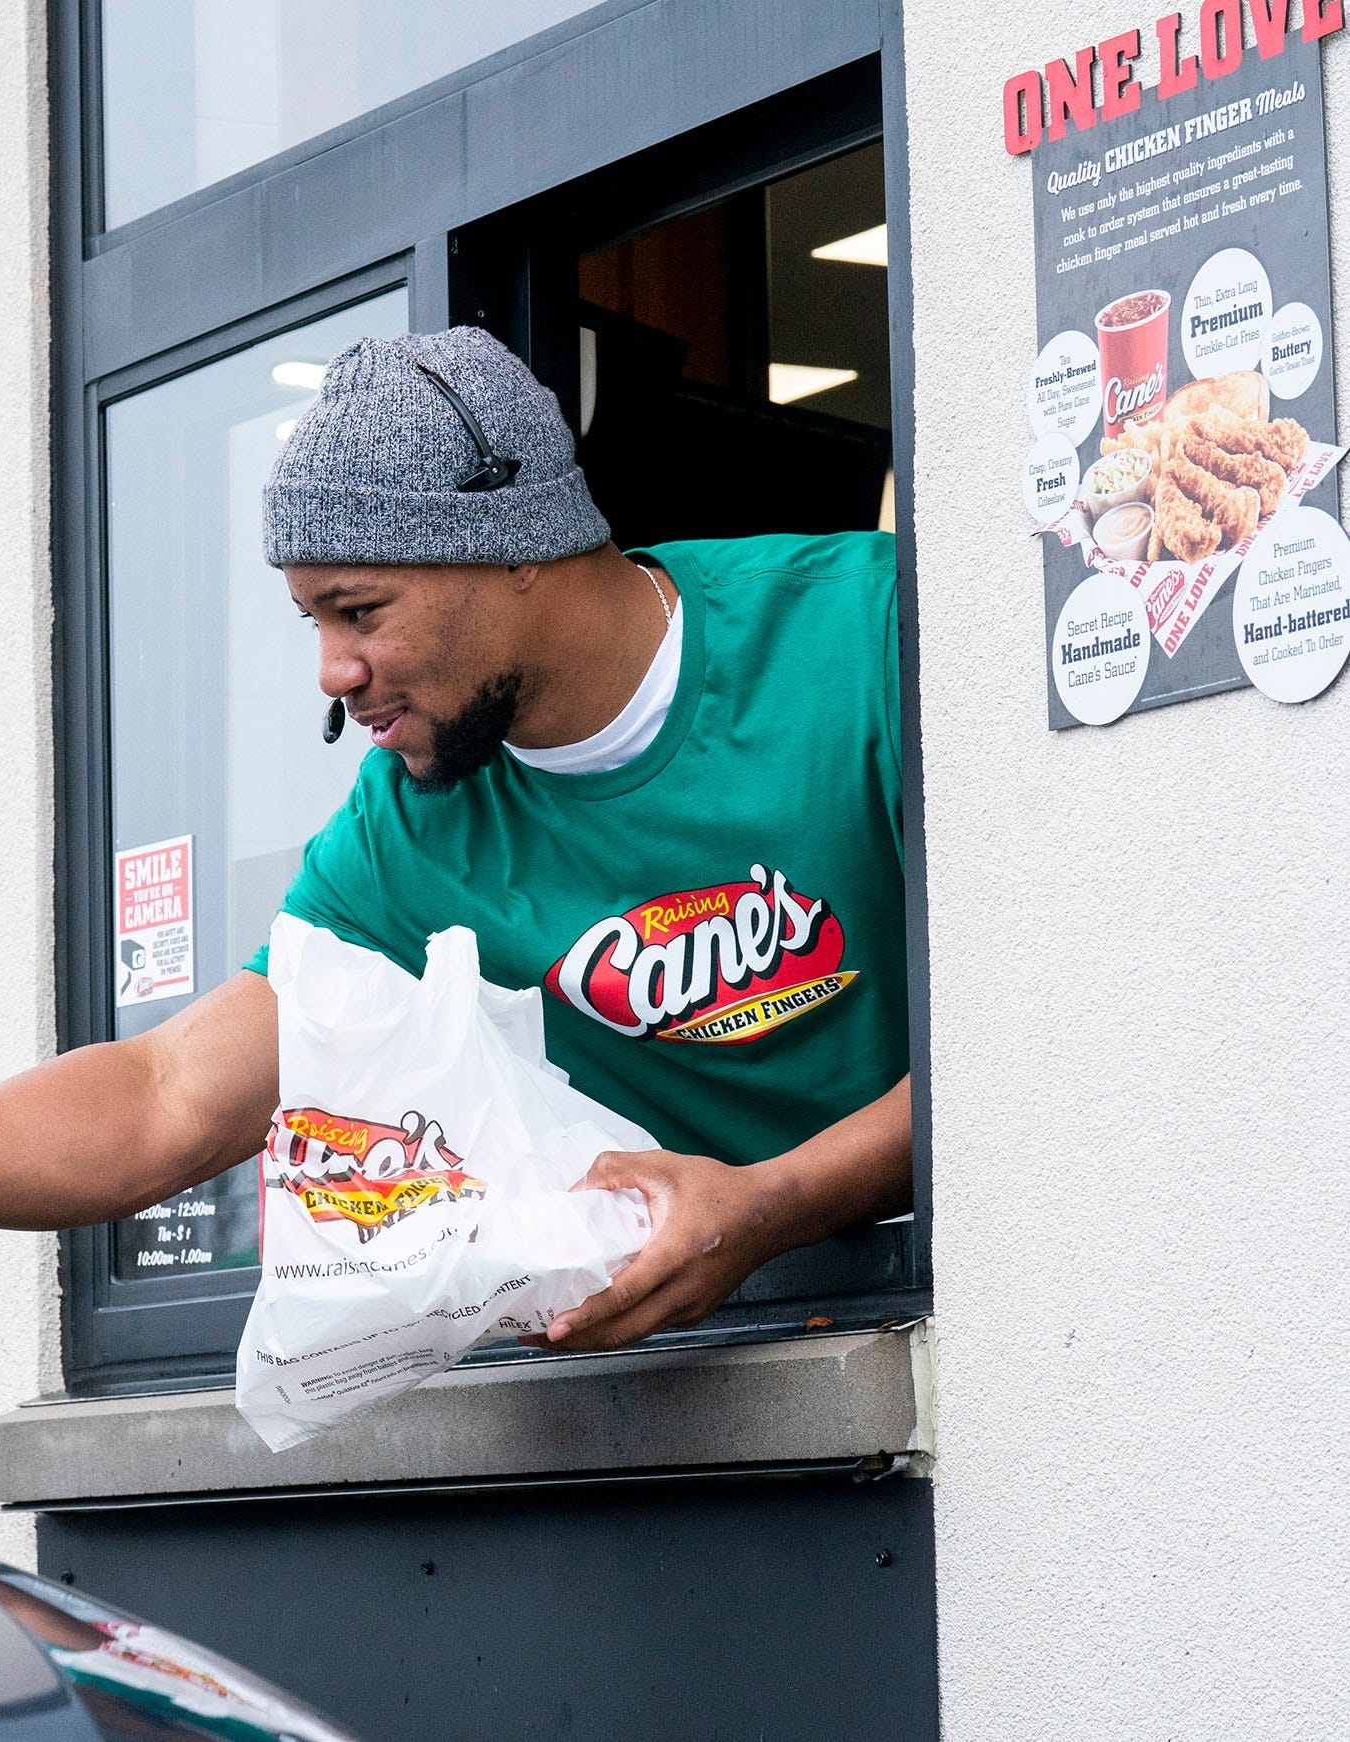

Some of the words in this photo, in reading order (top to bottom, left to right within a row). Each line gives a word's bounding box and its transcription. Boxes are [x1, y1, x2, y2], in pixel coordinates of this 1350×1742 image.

[1003, 29, 1142, 155] ONE
[1047, 160, 1102, 195] Quality
[1105, 132, 1181, 174] CHICKEN
[1185, 97, 1253, 143] FINGER
[1255, 81, 1305, 116] Meals
[1061, 208, 1075, 222] We
[1078, 203, 1095, 217] use
[1097, 194, 1116, 211] only
[1119, 186, 1134, 200] the
[1136, 172, 1171, 197] highest
[1173, 162, 1205, 184] quality
[1207, 140, 1261, 172] ingredients
[1264, 132, 1285, 150] with
[1288, 129, 1295, 140] a
[1063, 231, 1086, 247] cook
[1088, 226, 1097, 238] to
[1099, 215, 1124, 235] order
[1127, 205, 1160, 228] system
[1162, 198, 1181, 213] that
[1183, 183, 1221, 206] ensures
[1223, 179, 1230, 190] a
[1232, 154, 1294, 189] great-tasting
[1056, 247, 1092, 274] chicken
[1094, 242, 1122, 263] finger
[1124, 234, 1147, 252] meal
[1150, 220, 1181, 242] served
[1183, 212, 1200, 228] hot
[1201, 207, 1219, 223] and
[1221, 194, 1246, 217] fresh
[1249, 188, 1276, 211] every
[1279, 179, 1303, 195] time.
[1194, 295, 1213, 309] Thin,
[1216, 288, 1236, 302] Extra
[1239, 280, 1258, 295] Long
[1191, 302, 1263, 338] Premium
[1195, 334, 1239, 358] Crinkle-Cut
[1241, 330, 1259, 344] Fries
[1272, 339, 1311, 361] Buttery
[1035, 361, 1096, 389] Freshly-Brewed
[1105, 363, 1164, 424] Cane's
[1036, 473, 1066, 493] Fresh
[1273, 537, 1315, 558] Premium
[1130, 561, 1153, 588] OVE
[1259, 564, 1295, 586] Chicken
[1297, 558, 1332, 577] Fingers
[1164, 611, 1190, 653] ONE
[1185, 564, 1214, 611] LOVE
[1250, 596, 1271, 612] That
[1274, 592, 1290, 605] Are
[1294, 577, 1342, 599] Marinated,
[1068, 619, 1097, 636] Secret
[1101, 610, 1134, 629] Recipe
[1244, 599, 1350, 644] Hand-battered
[1062, 629, 1140, 664] Handmade
[1253, 650, 1269, 666] and
[1271, 644, 1304, 663] Cooked
[1307, 641, 1317, 653] To
[1319, 634, 1343, 650] Order
[1069, 666, 1101, 687] Cane's
[125, 849, 182, 890] SMILE
[162, 882, 173, 896] ON
[125, 896, 182, 929] CAMERA
[641, 892, 730, 940] Raising
[558, 863, 823, 1038] Cane's
[676, 1007, 759, 1041] CHICKEN
[761, 977, 841, 1022] FINGERS
[289, 1115, 370, 1154] Raising
[499, 1320, 531, 1329] HILEX
[256, 1350, 274, 1364] THIS
[276, 1357, 299, 1366] BAG
[317, 1380, 335, 1391] plastic
[335, 1377, 347, 1387] bag
[363, 1366, 378, 1375] from
